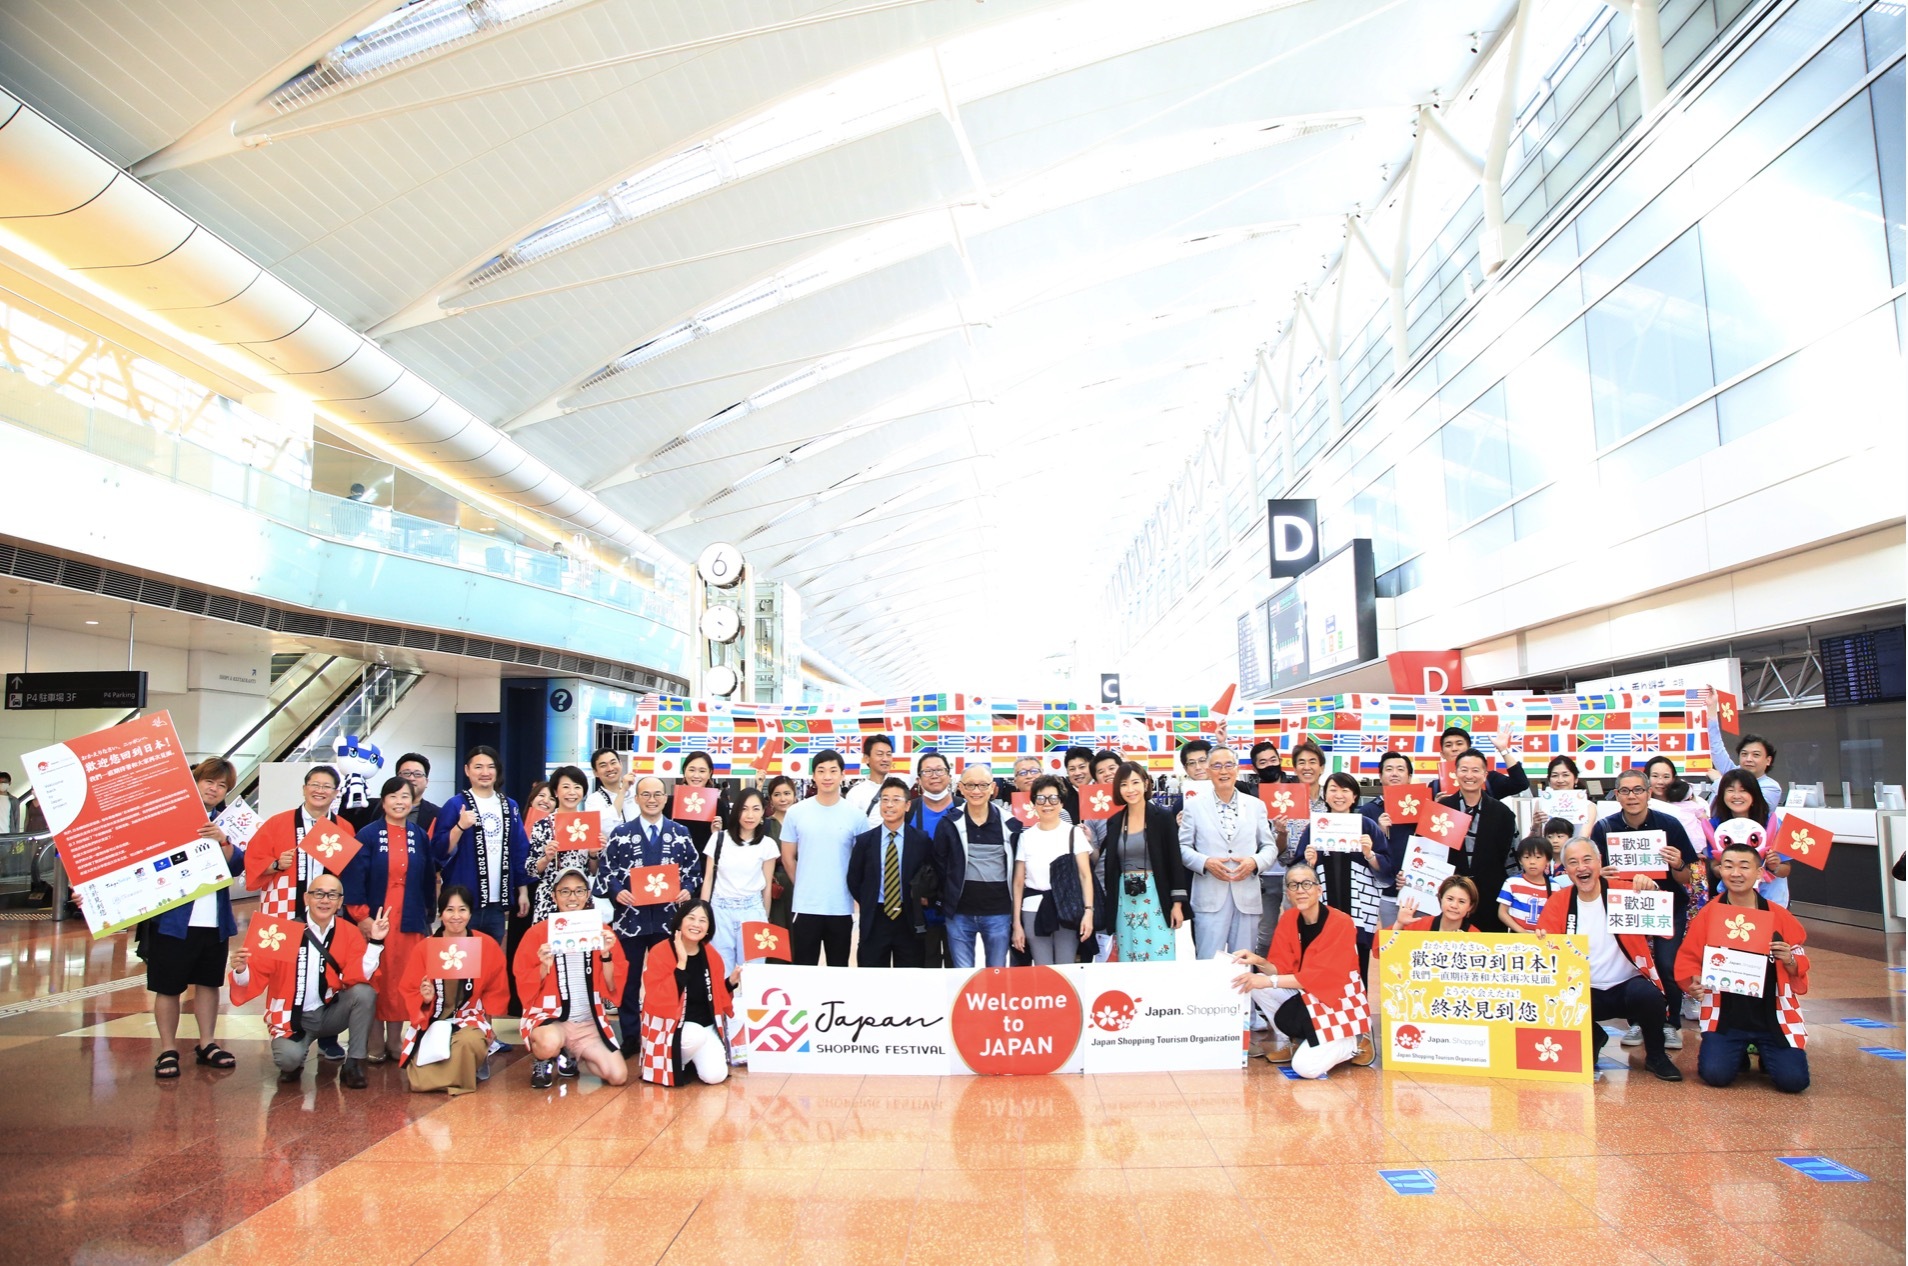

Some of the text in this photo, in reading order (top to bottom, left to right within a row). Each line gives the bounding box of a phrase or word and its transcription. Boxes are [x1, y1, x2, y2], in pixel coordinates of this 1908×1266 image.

[1273, 515, 1314, 561] D
[712, 551, 727, 577] 6
[1102, 678, 1118, 698] C
[1422, 666, 1449, 695] D
[26, 692, 77, 702] P4 駐車場 3F
[112, 691, 136, 699] Parking
[475, 830, 485, 855] TOKYO
[1622, 837, 1650, 851] 歡迎
[477, 857, 487, 876] 2020
[1610, 853, 1667, 866] 來到東京
[1526, 897, 1539, 924] 1
[1624, 896, 1655, 911] 歡迎
[1609, 913, 1672, 929] 來到東京
[1411, 951, 1557, 973] 歡迎您回到日本!
[704, 969, 713, 1002] JSTO
[965, 991, 1067, 1011] Welcome
[1145, 1002, 1241, 1019] Japan. Shopping!
[1431, 999, 1538, 1022] 終於見到您
[815, 1000, 945, 1043] Japan
[1002, 1016, 1024, 1033] to
[979, 1036, 1053, 1057] JAPAN
[1091, 1033, 1240, 1048] Japan Shopping Tourism Organization
[1427, 1035, 1450, 1044] Japan.
[816, 1044, 946, 1055] SHOPPING FESTIVAL
[1412, 1053, 1434, 1061] Shopping
[1455, 1055, 1487, 1064] Organization
